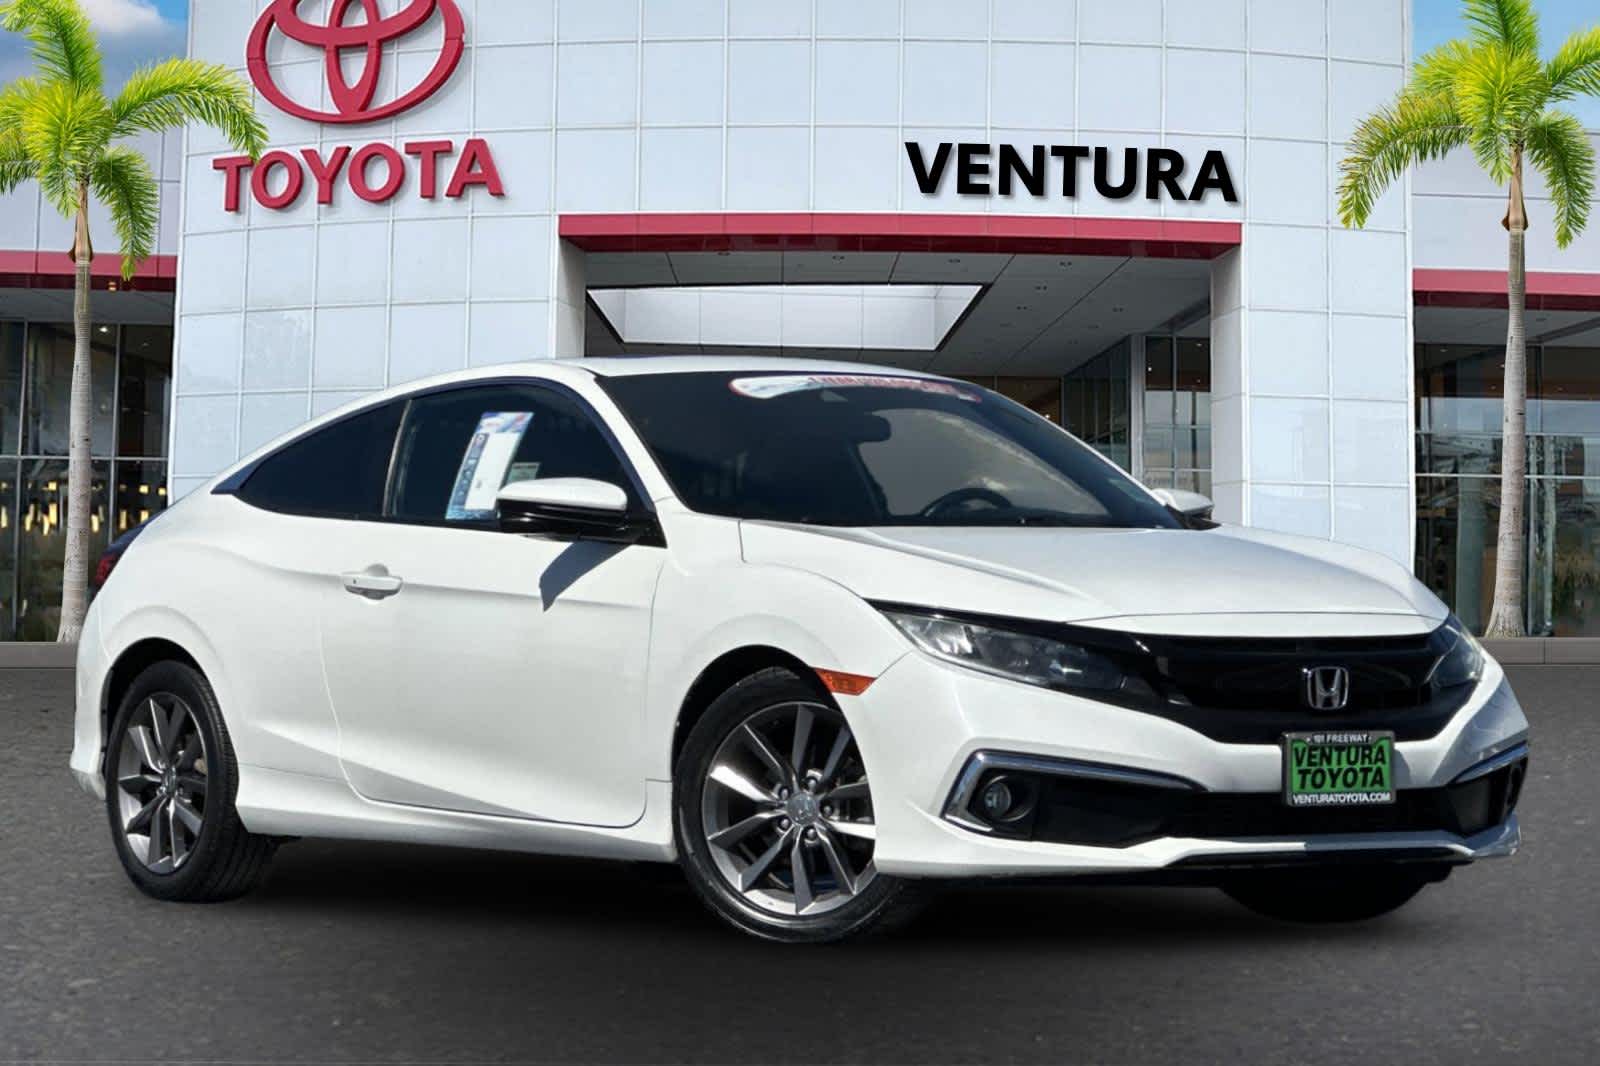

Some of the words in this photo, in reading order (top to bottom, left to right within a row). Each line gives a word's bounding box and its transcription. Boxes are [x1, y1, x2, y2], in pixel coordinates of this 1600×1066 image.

[212, 138, 505, 212] TOYOTA
[904, 142, 1239, 203] VENTURA
[1294, 744, 1386, 767] VENTURA
[1297, 767, 1385, 789] TOYOTA
[1293, 792, 1391, 804] VENTURATOYOTA.COM
